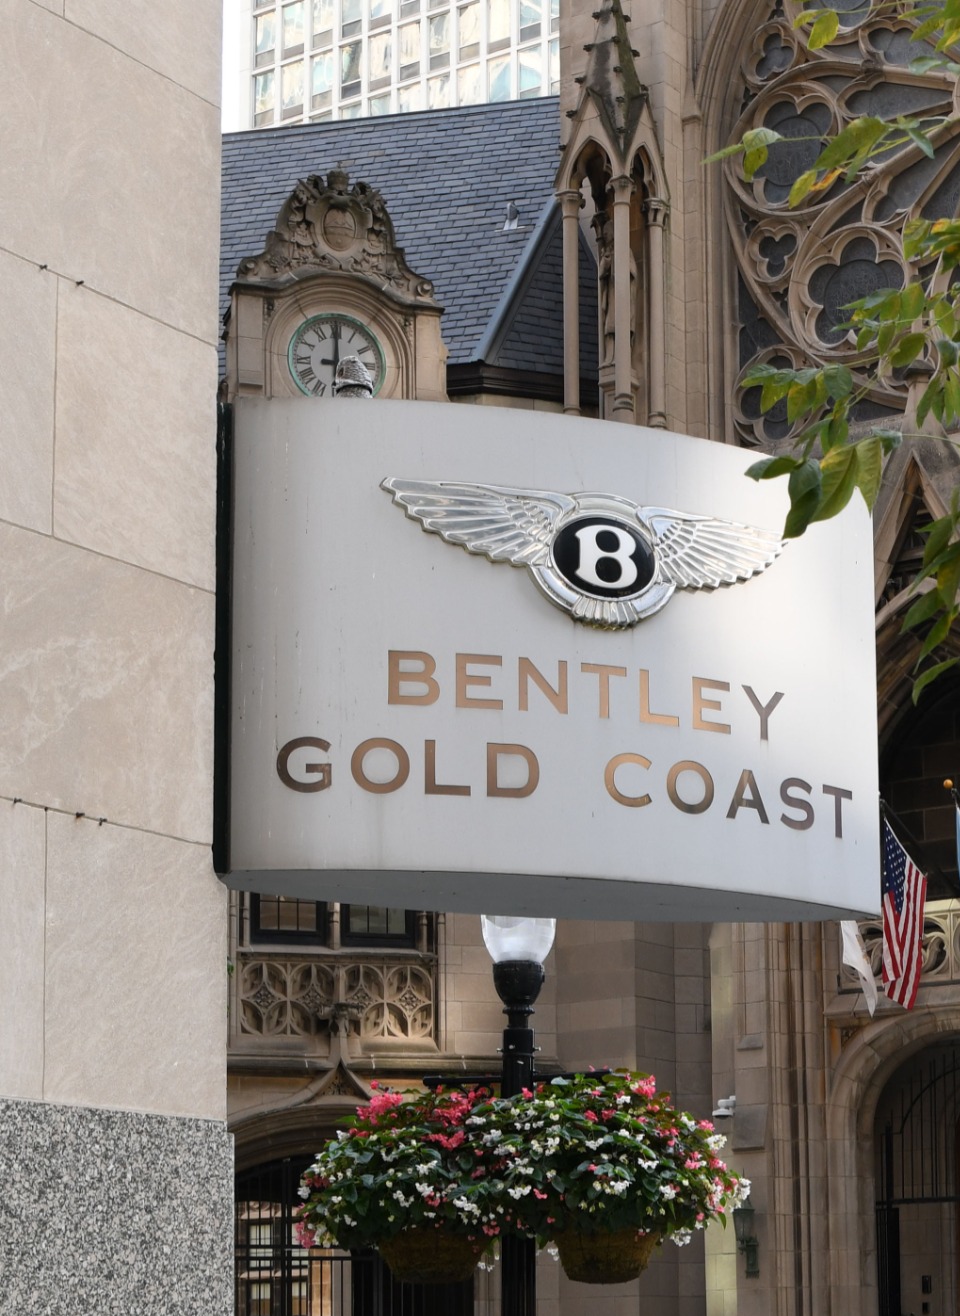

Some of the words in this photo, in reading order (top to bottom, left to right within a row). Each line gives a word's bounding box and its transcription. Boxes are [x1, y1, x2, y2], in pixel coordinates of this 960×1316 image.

[387, 649, 785, 741] BENTLEY
[276, 736, 540, 798] GOLD
[604, 752, 853, 839] COAST
